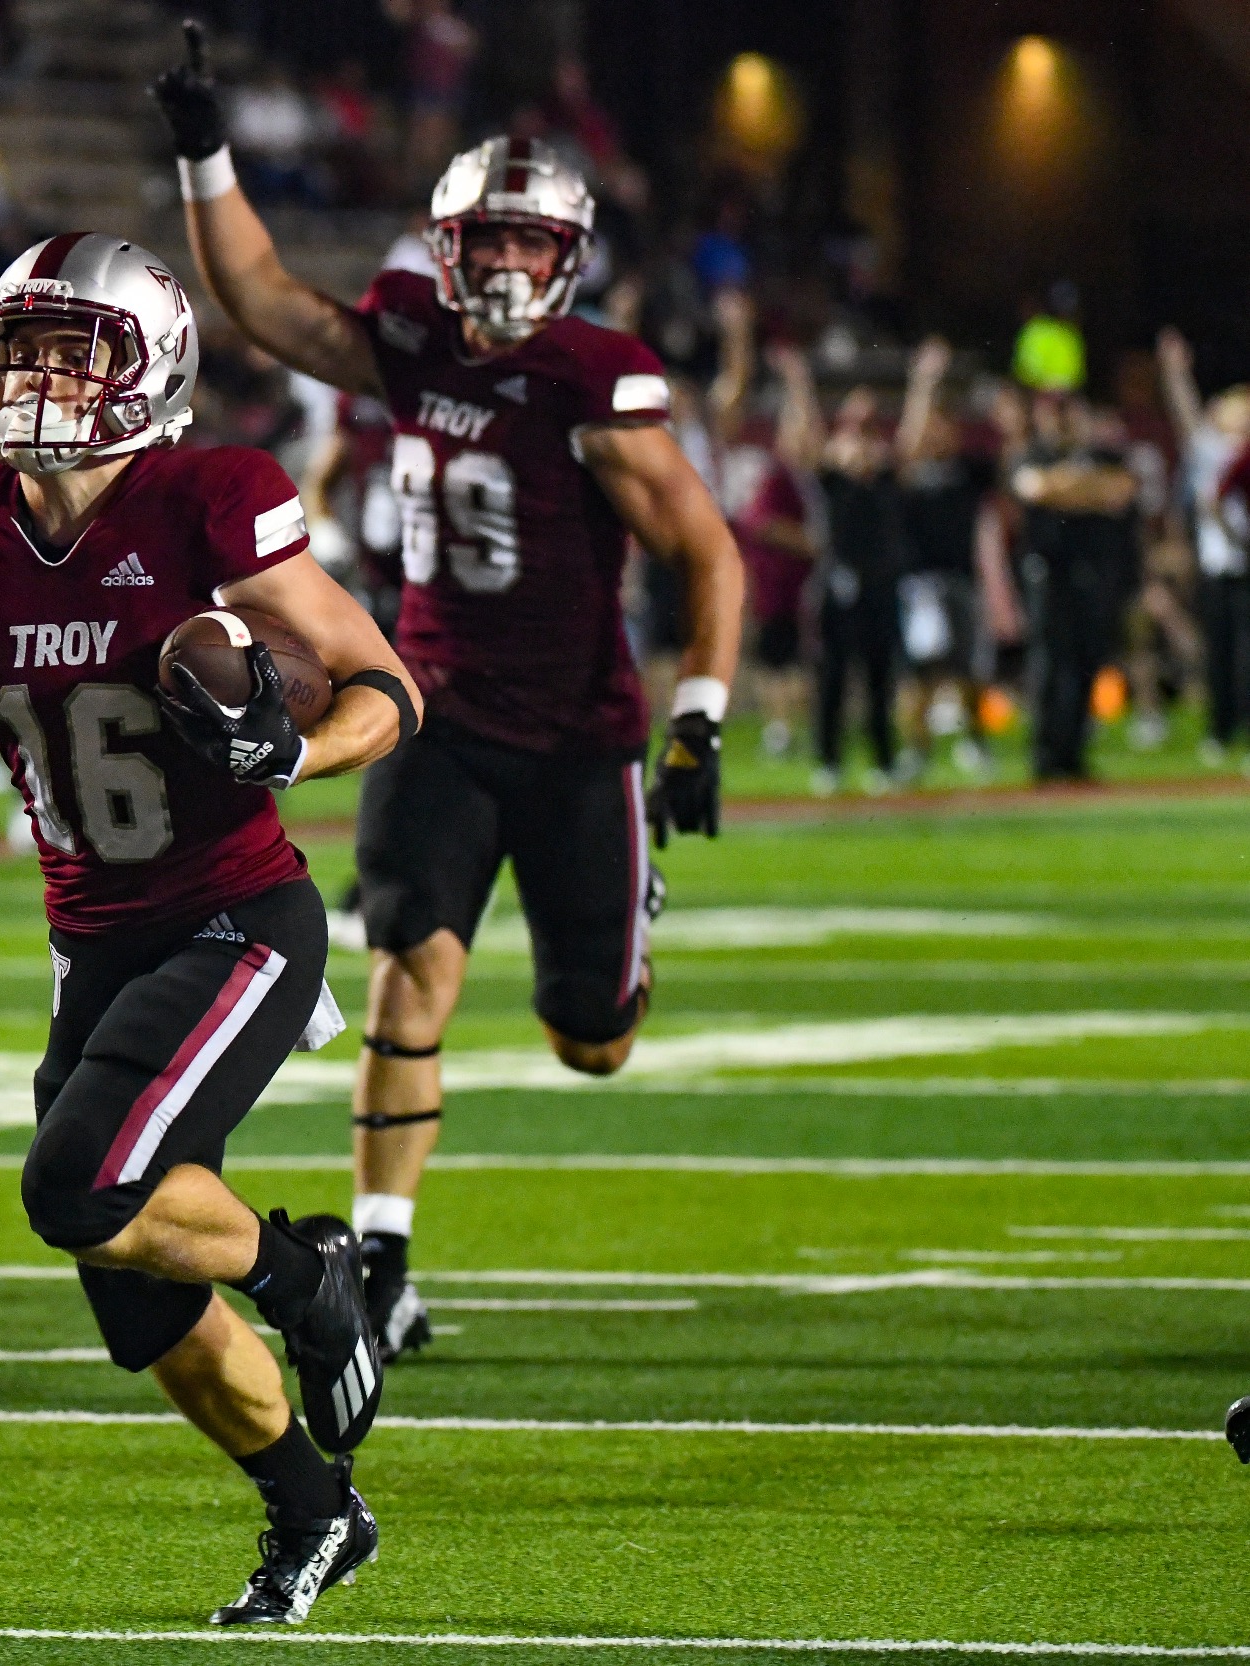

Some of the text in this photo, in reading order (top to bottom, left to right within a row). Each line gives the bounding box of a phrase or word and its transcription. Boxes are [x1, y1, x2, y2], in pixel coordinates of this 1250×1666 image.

[17, 281, 55, 294] TROY
[416, 391, 495, 442] TROY
[100, 573, 155, 586] adidas
[9, 620, 119, 668] TROY
[233, 741, 274, 775] adidas
